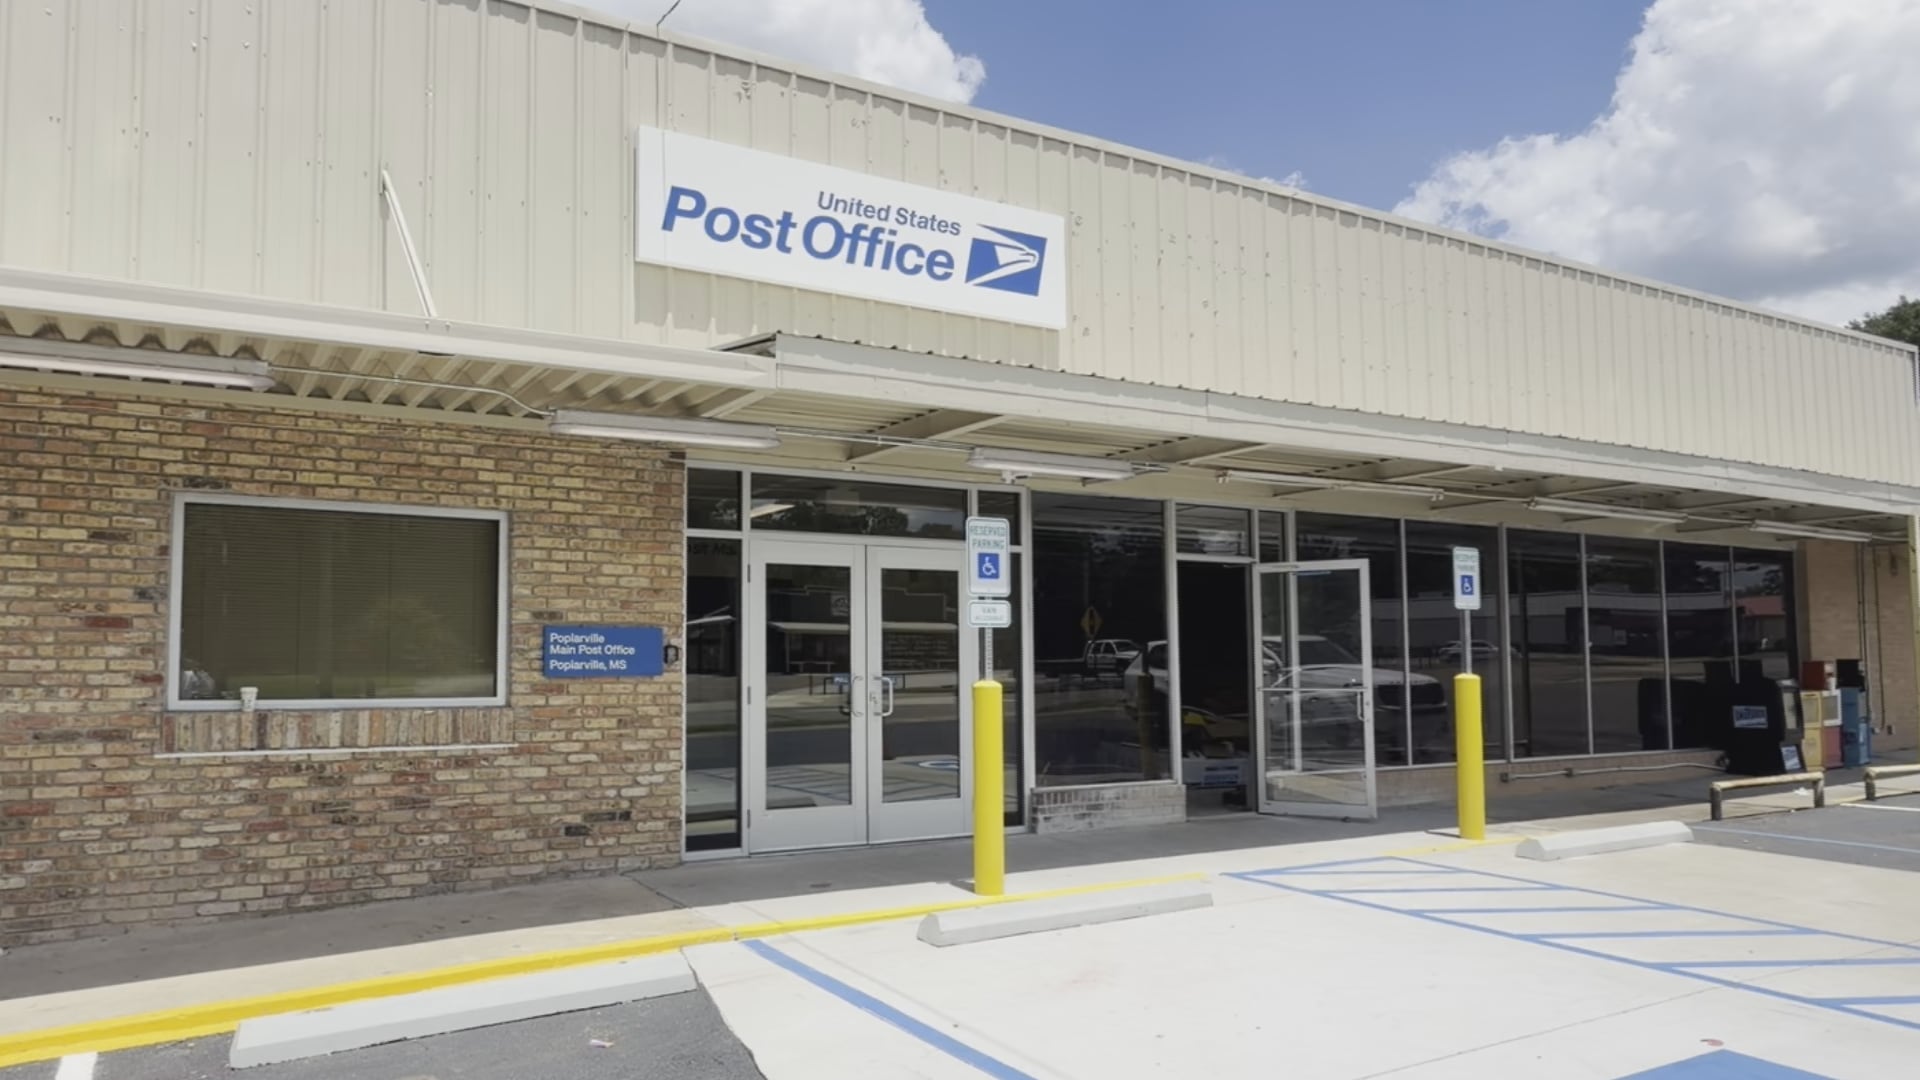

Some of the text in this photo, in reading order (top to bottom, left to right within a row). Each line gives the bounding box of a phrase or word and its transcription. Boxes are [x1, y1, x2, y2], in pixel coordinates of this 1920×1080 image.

[817, 190, 962, 236] United States
[661, 185, 955, 281] Post Office
[969, 526, 1006, 537] RESERVED
[971, 538, 1005, 550] PARKING
[550, 632, 605, 644] Poplarville
[550, 644, 636, 656] Main Post Office
[550, 659, 627, 672] Poplarville, MS
